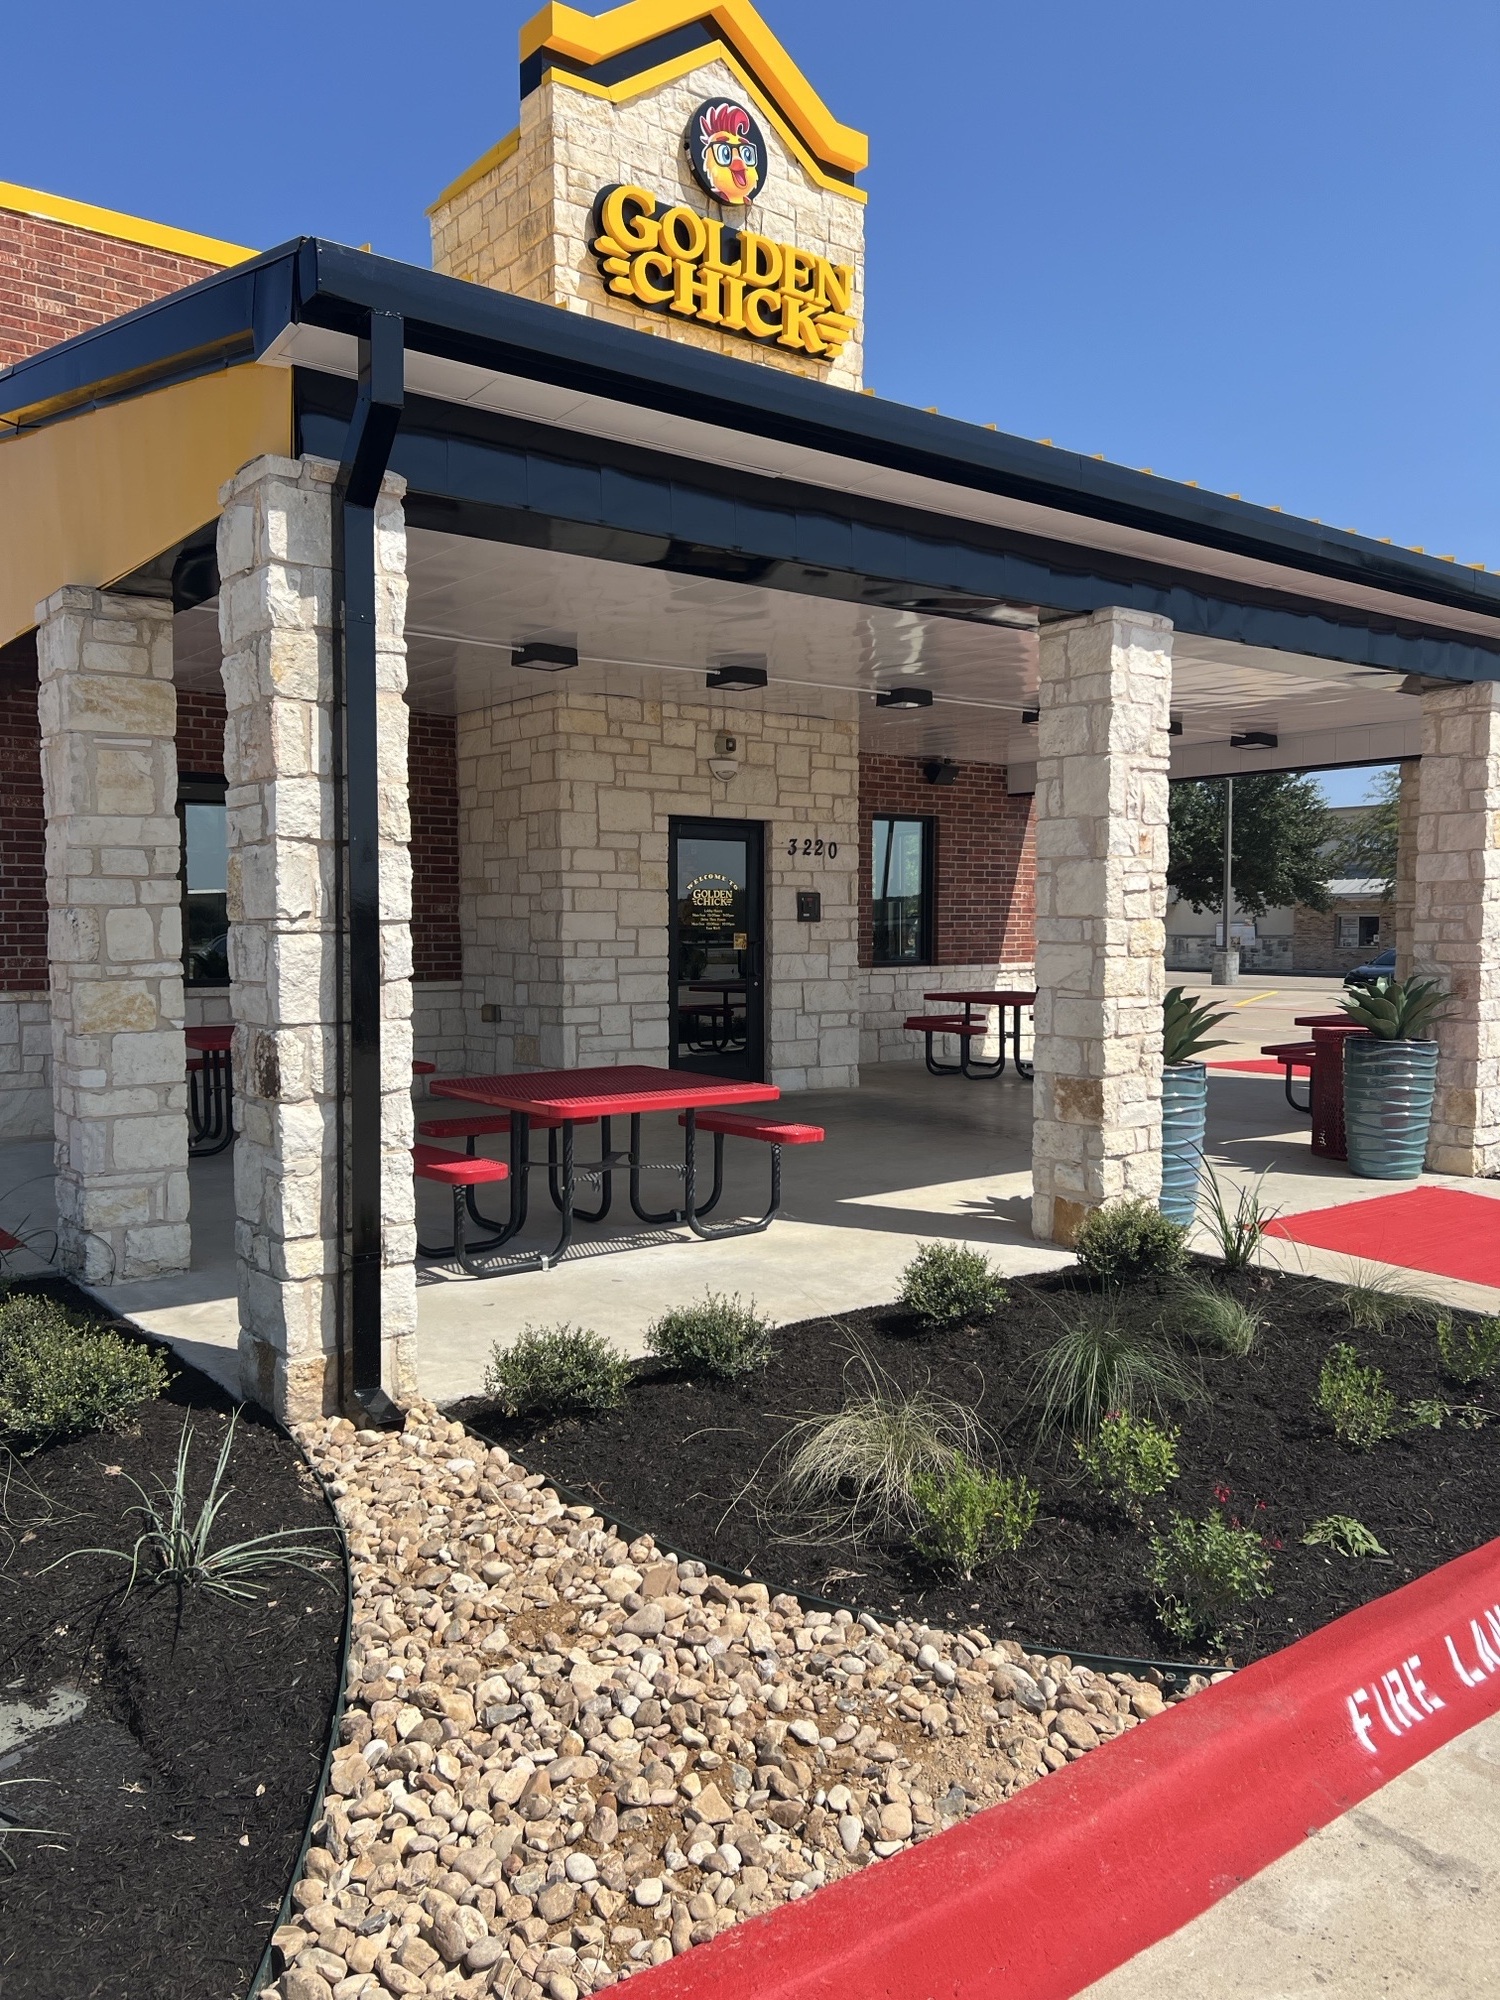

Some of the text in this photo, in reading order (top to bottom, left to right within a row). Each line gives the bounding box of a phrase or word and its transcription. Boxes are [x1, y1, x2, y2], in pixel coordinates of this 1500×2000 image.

[602, 184, 854, 313] GOLDEN
[629, 251, 828, 353] CHICK
[787, 838, 838, 859] 3220
[686, 873, 738, 890] WELCOME TO
[693, 889, 733, 898] GOLDEN
[696, 898, 728, 906] CHICK
[1346, 1654, 1447, 1753] FIRE
